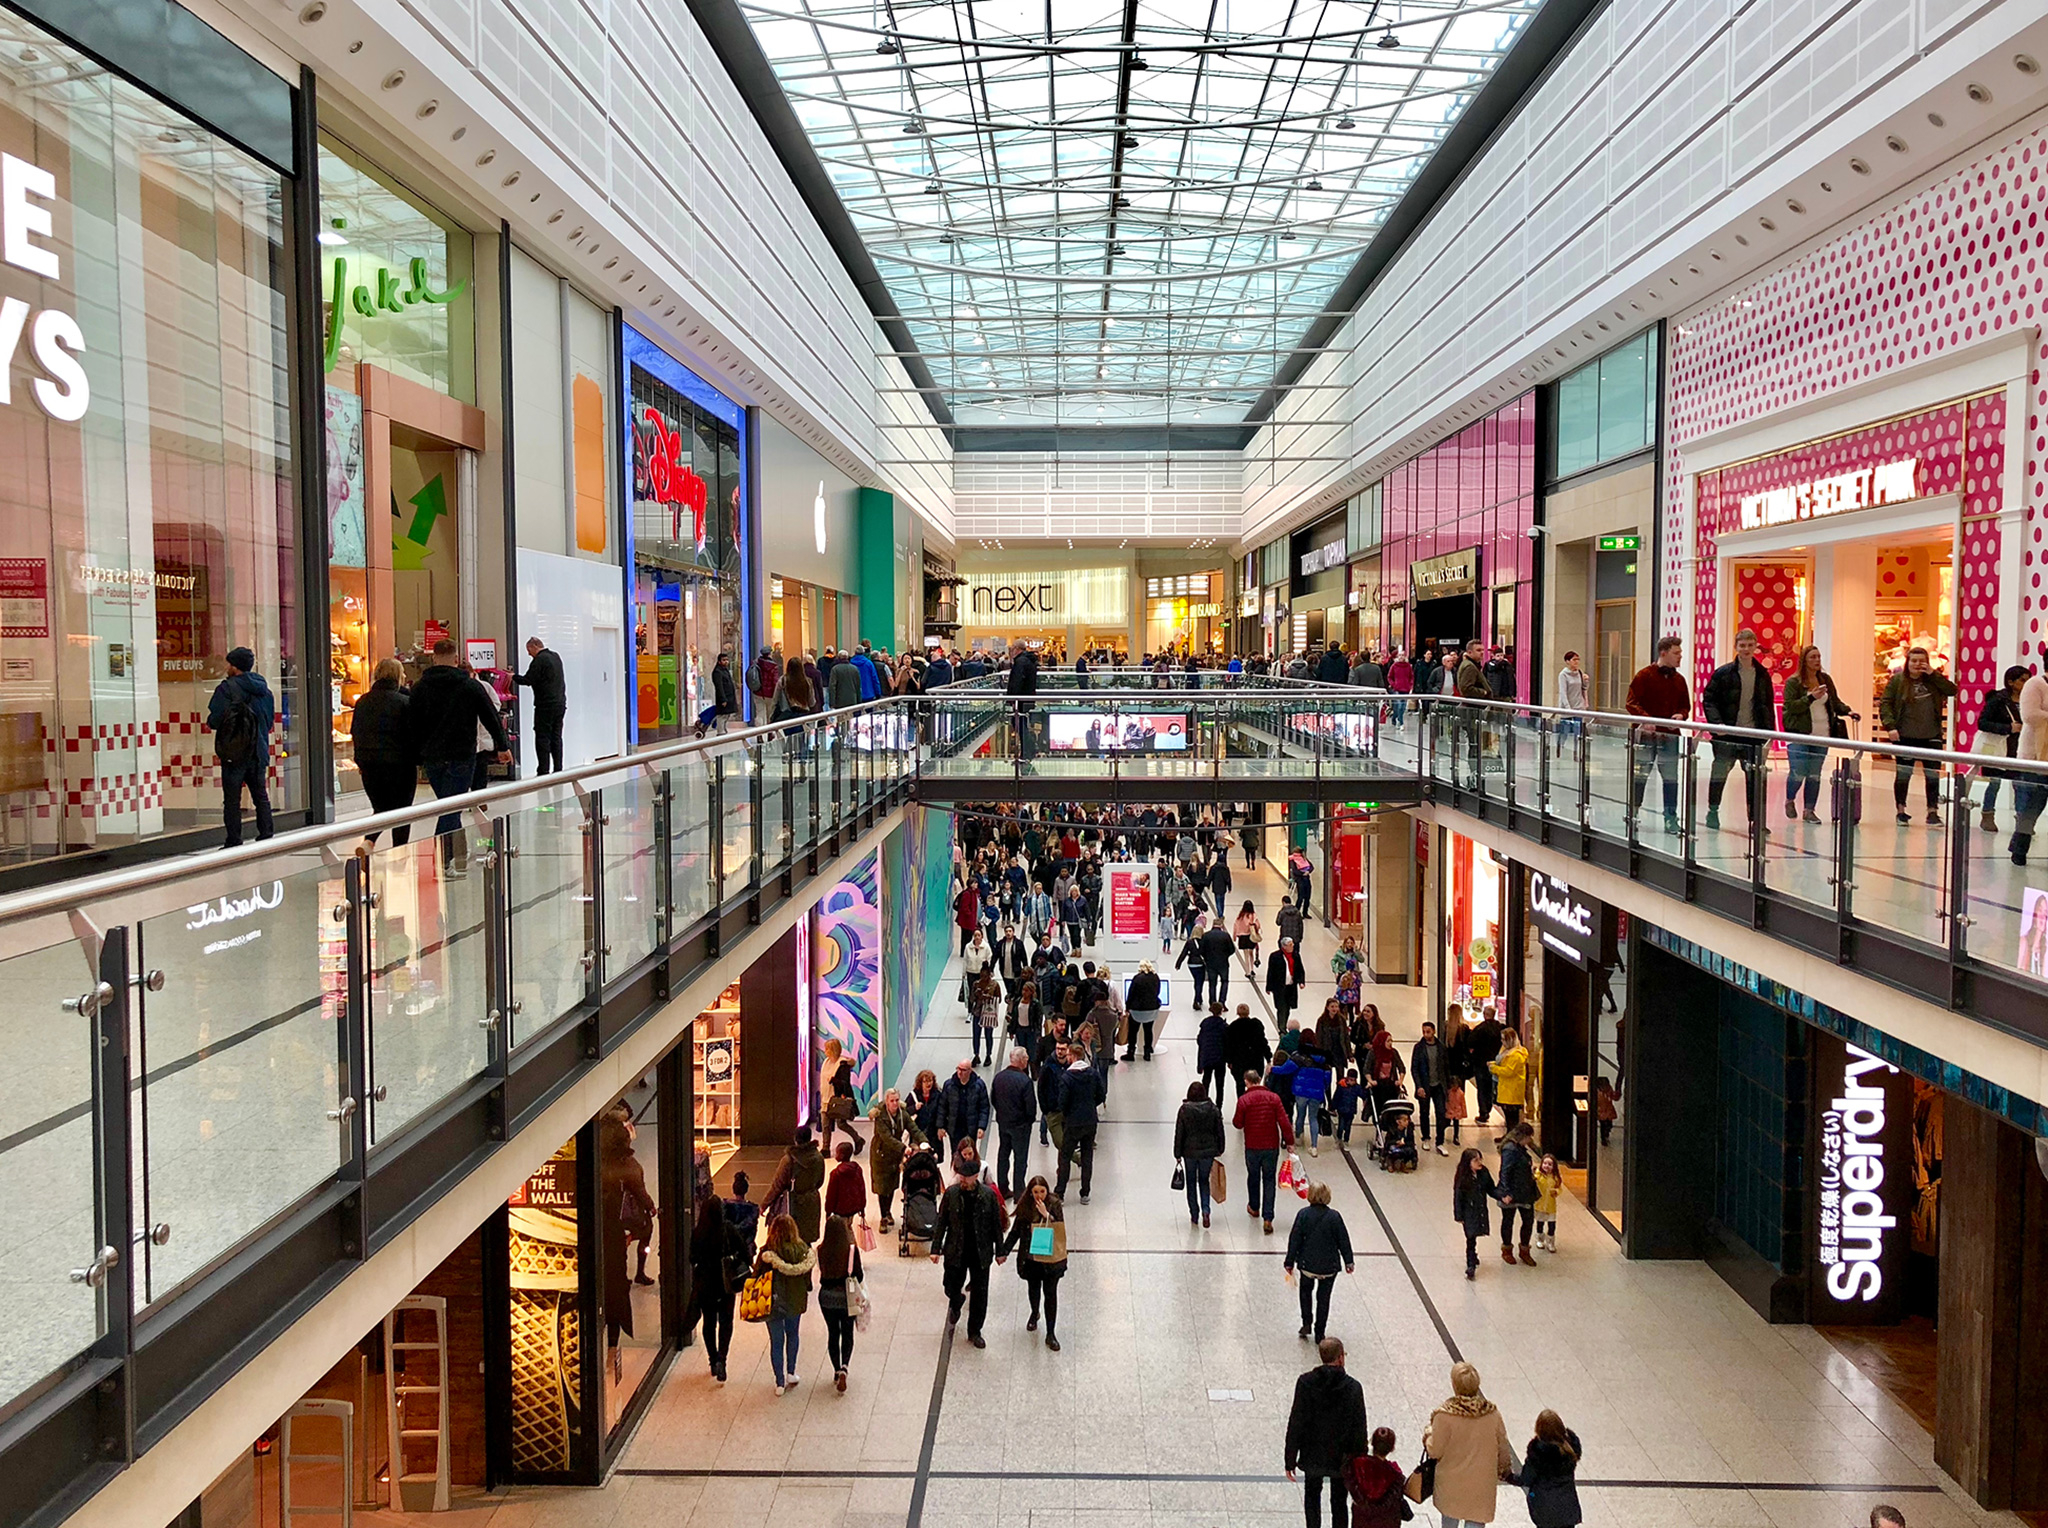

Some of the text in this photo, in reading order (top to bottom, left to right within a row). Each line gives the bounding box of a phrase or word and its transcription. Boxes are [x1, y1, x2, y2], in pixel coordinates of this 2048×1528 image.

[1741, 458, 1917, 530] VICTORIA'S SECRET PINK
[973, 583, 1053, 613] next
[163, 660, 182, 671] FIVE
[469, 650, 495, 661] HUNTER
[1827, 1042, 1900, 1302] Superdry
[531, 1178, 556, 1190] THE
